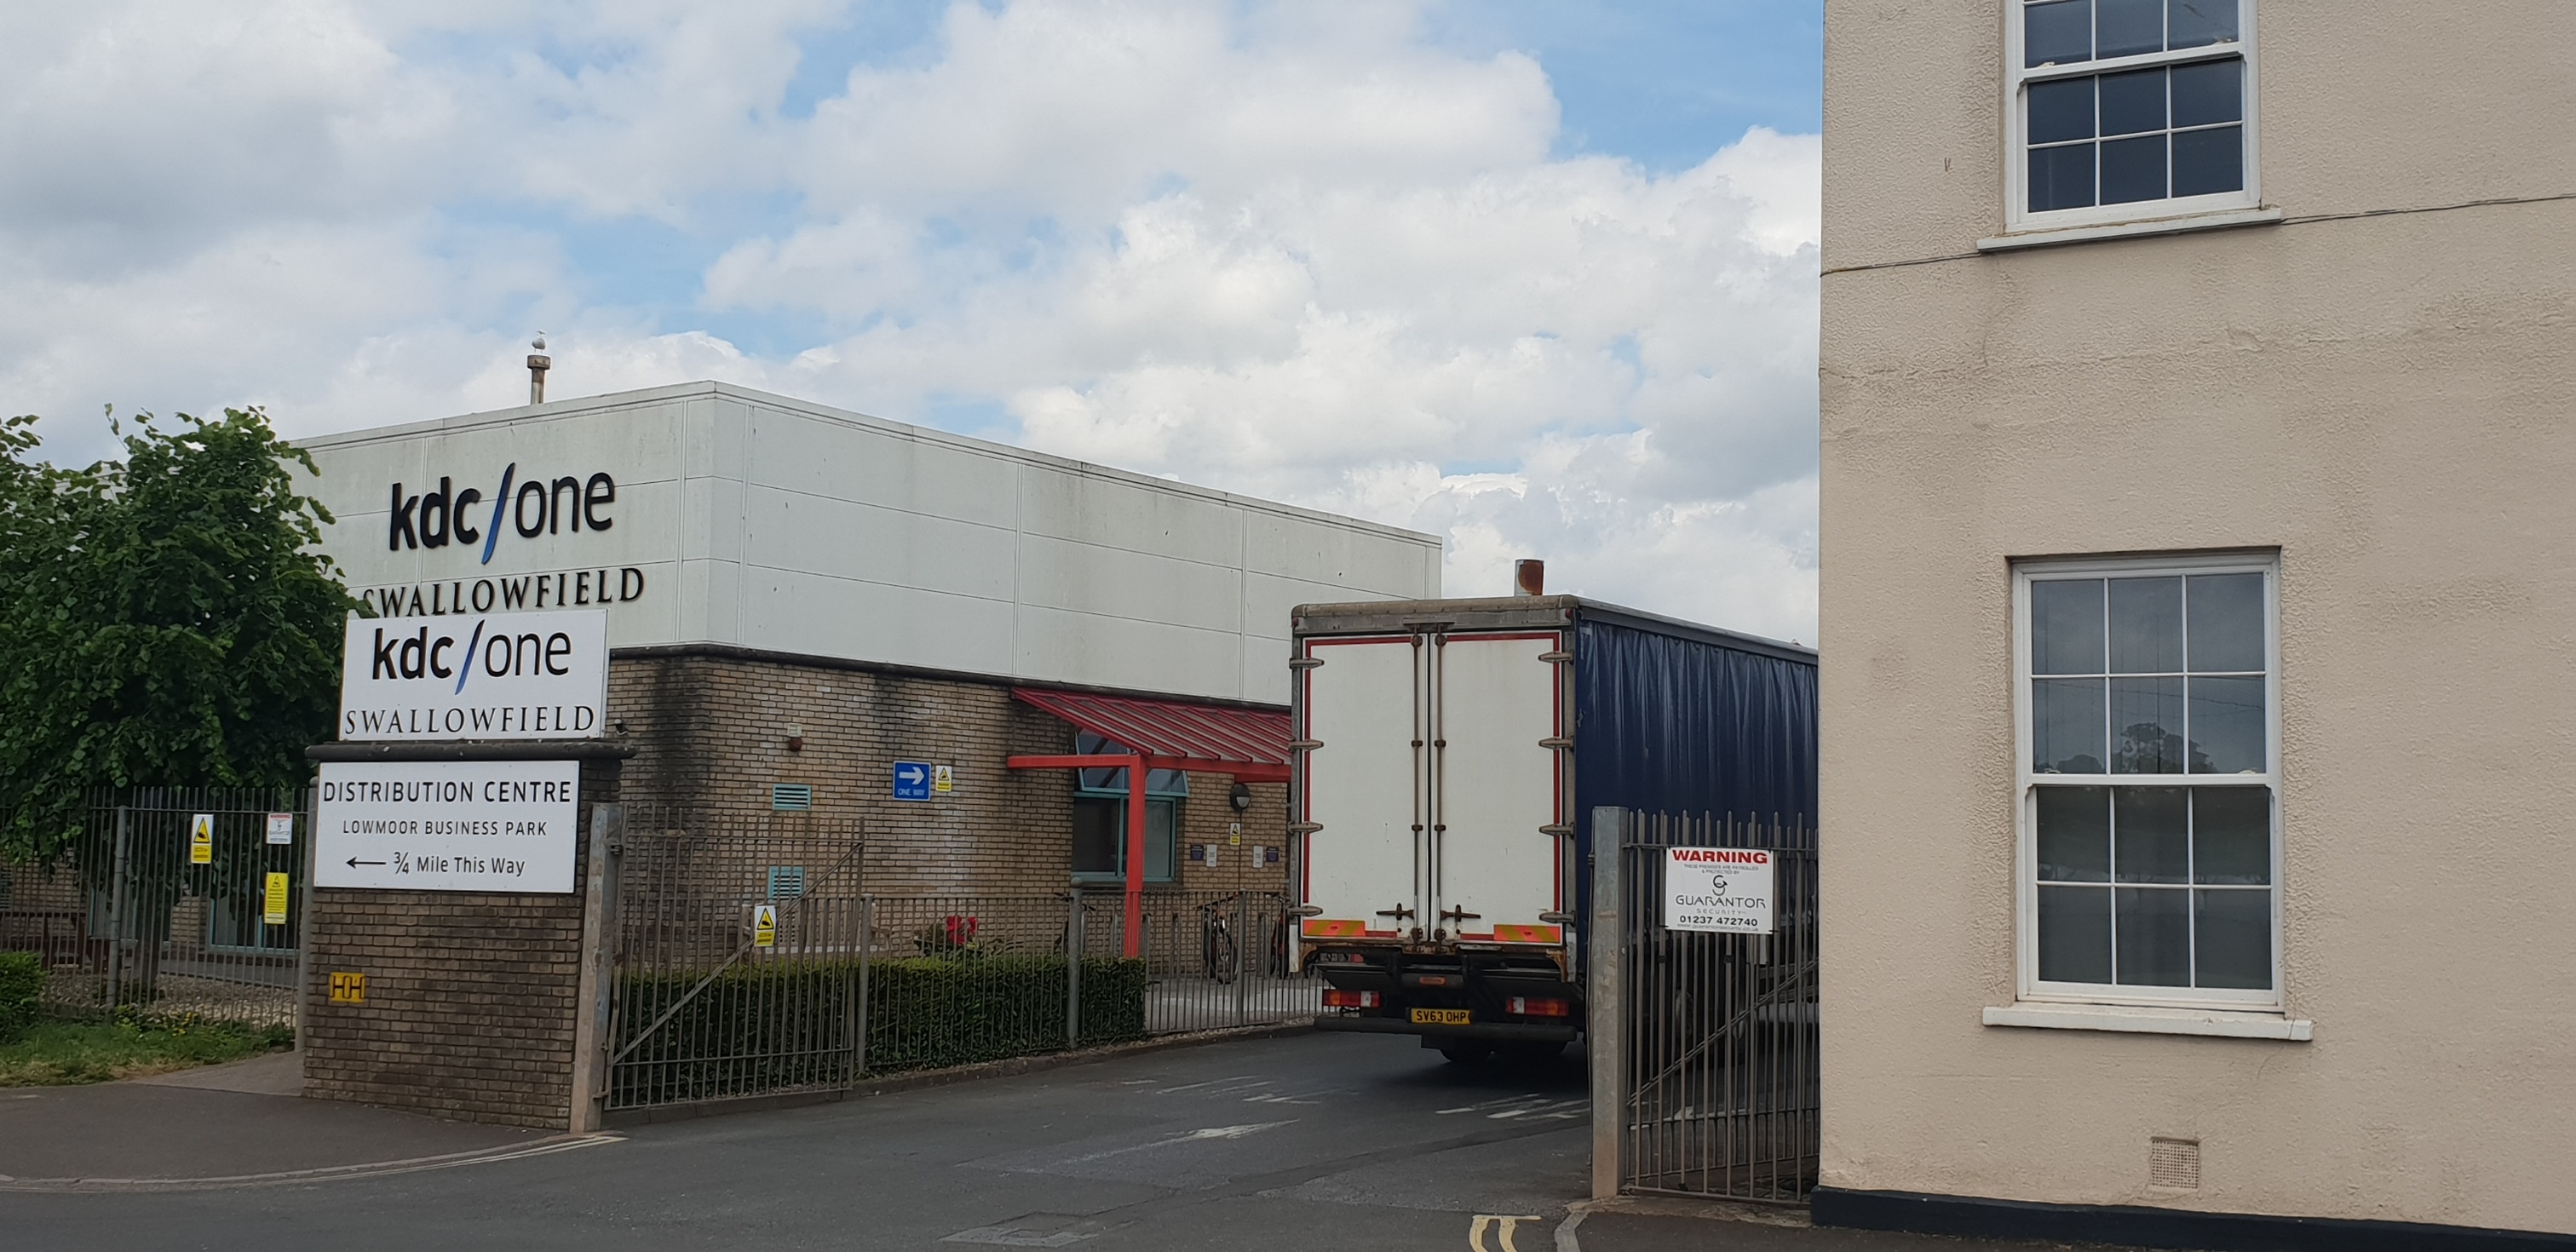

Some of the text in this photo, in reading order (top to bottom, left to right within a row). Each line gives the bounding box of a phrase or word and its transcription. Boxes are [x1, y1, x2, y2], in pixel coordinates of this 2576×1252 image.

[389, 462, 615, 566] kdc/one
[372, 619, 572, 696] kdc/one
[345, 705, 595, 735] SWALLOWFIELD
[323, 781, 572, 803] DISTRIBUTION CENTRE
[342, 819, 548, 836] LOWMOOR BUSINESS PARK
[1672, 849, 1768, 864] WARNING
[417, 856, 449, 873] Mile
[454, 857, 486, 874] This
[492, 857, 526, 877] Way
[1676, 894, 1767, 910] GUARANTOR
[1679, 915, 1758, 927] 01237 472740
[1416, 1010, 1467, 1023] SV63 OHP
